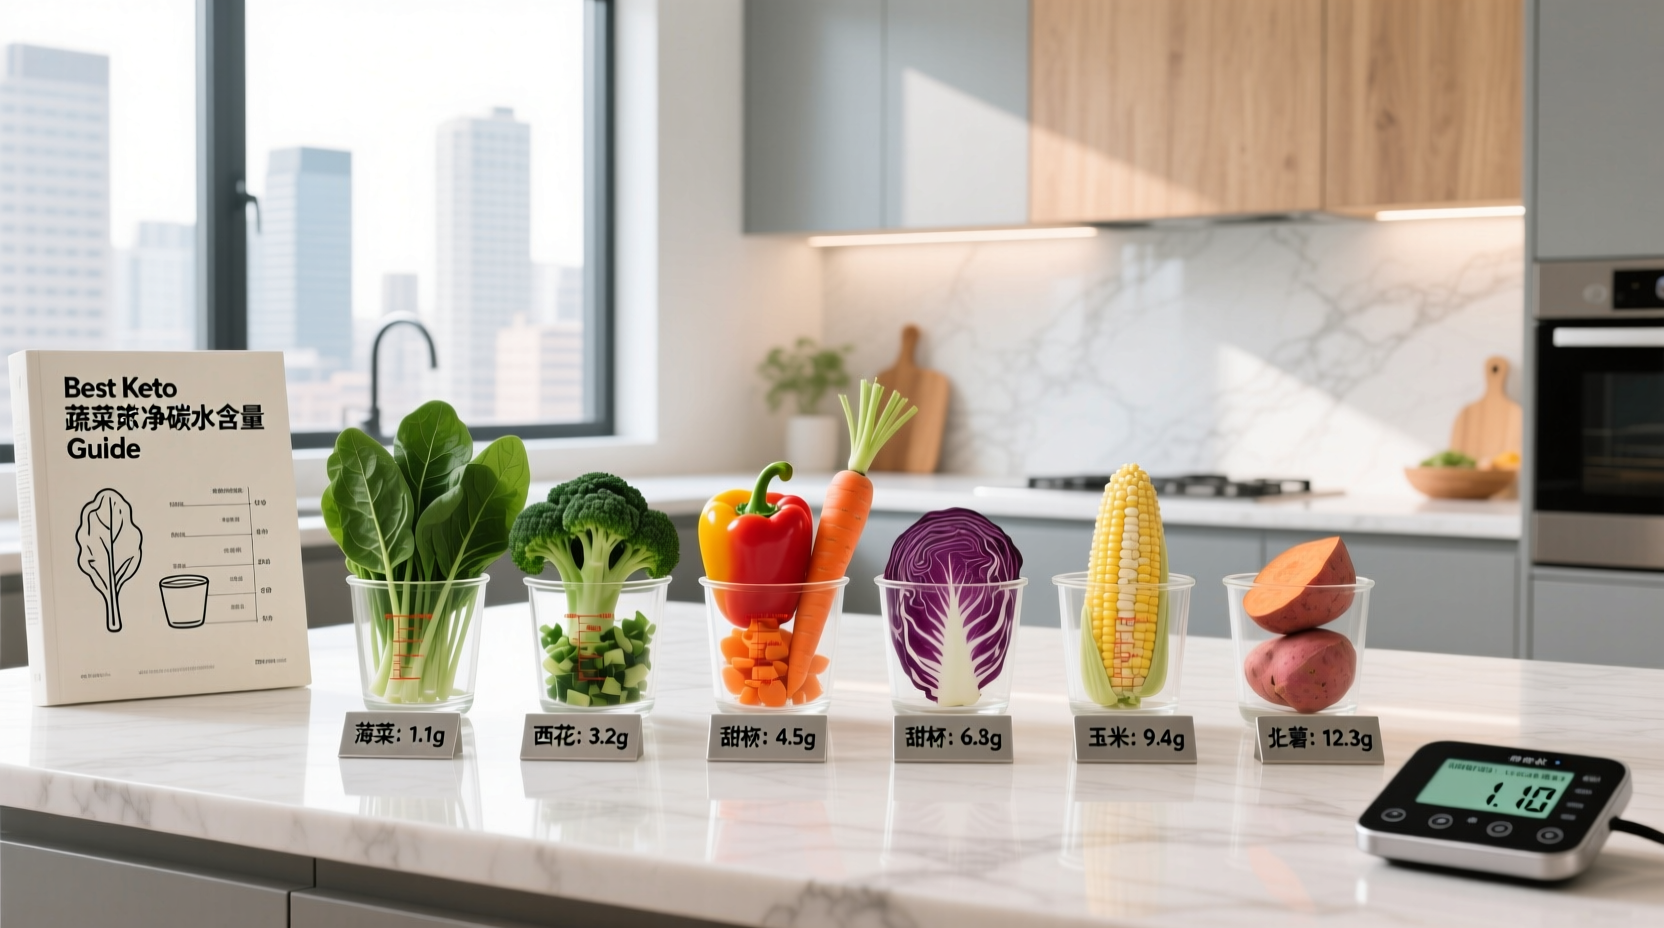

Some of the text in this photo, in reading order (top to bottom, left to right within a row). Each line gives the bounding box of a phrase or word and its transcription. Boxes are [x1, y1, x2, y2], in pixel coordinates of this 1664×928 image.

[64, 376, 178, 399] Best Keto
[67, 436, 141, 460] Guide
[409, 725, 446, 748] 1.1g
[588, 726, 629, 751] 3.2g
[775, 727, 816, 751] 4.5g
[1143, 727, 1185, 752] 9.4g
[1322, 728, 1373, 752] 12.3g
[1485, 782, 1557, 813] 1.10
